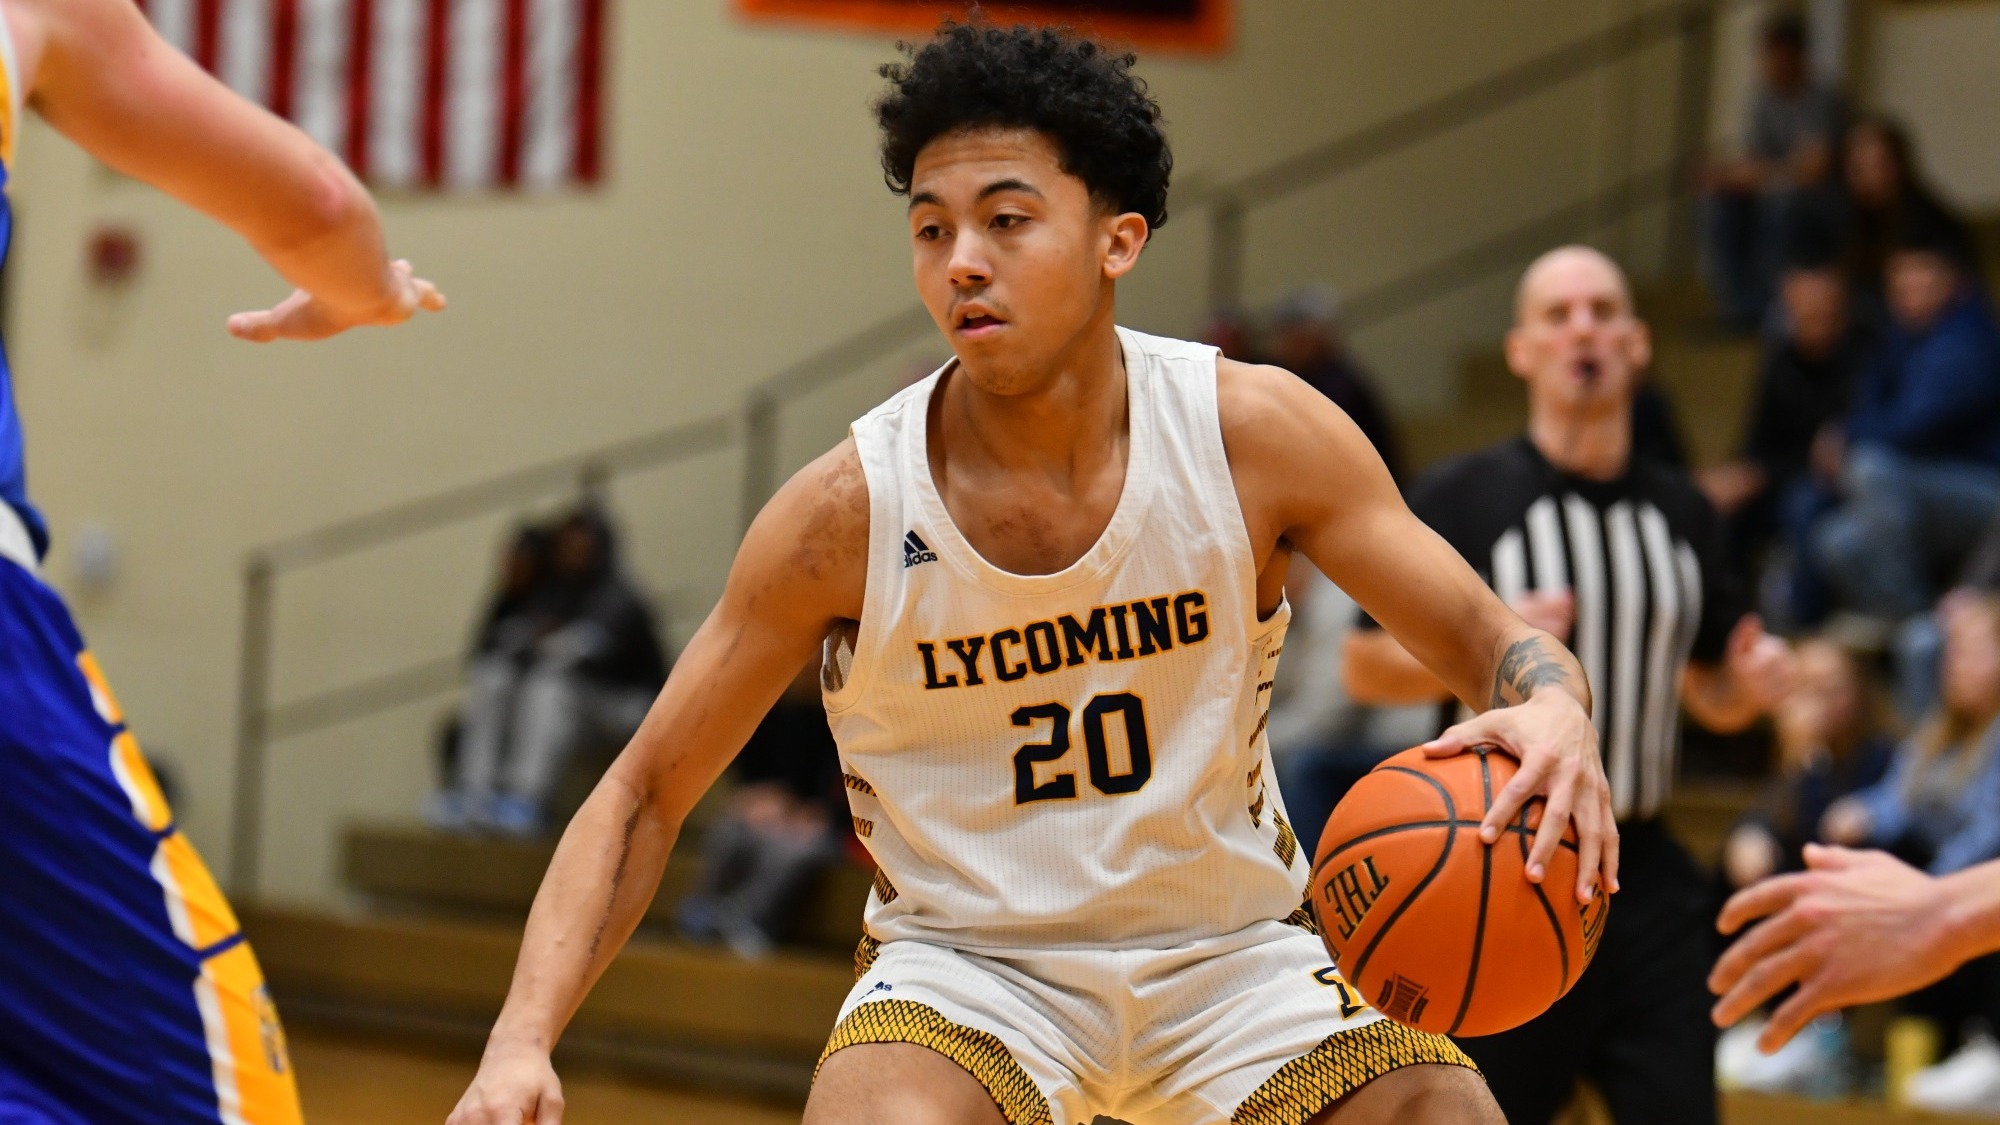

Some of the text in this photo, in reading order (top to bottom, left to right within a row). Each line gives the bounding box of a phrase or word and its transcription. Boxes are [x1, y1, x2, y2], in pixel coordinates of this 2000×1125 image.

[916, 589, 1211, 690] LYCOMING
[1010, 689, 1155, 807] 20
[1323, 855, 1390, 943] THE
